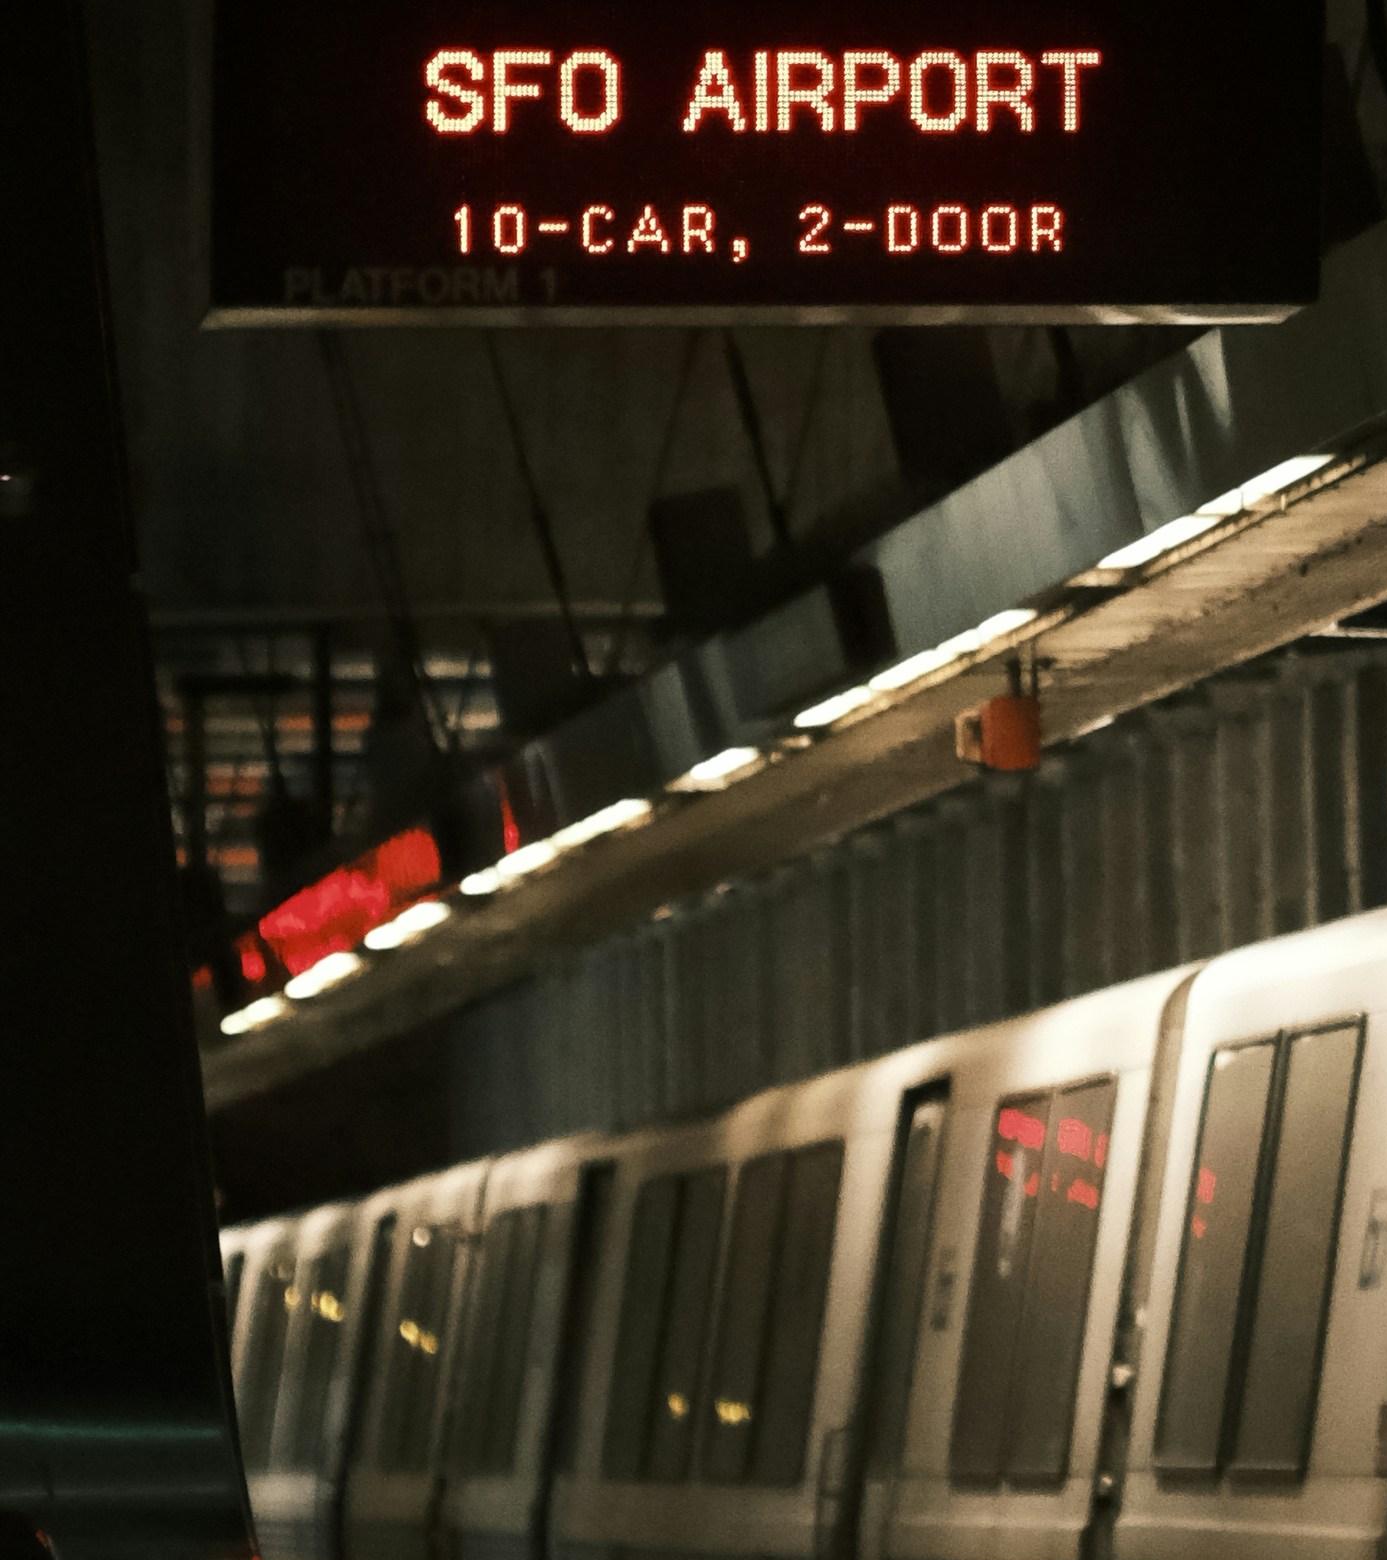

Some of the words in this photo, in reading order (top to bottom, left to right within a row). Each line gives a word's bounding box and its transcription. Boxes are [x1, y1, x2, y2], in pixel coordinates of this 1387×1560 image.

[424, 47, 622, 136] SFO
[681, 47, 1103, 135] AIRPORT
[453, 202, 750, 264] 10-CAR,
[798, 202, 1065, 255] 2-DOOR
[284, 266, 518, 302] PLATFORM
[540, 266, 558, 302] 1
